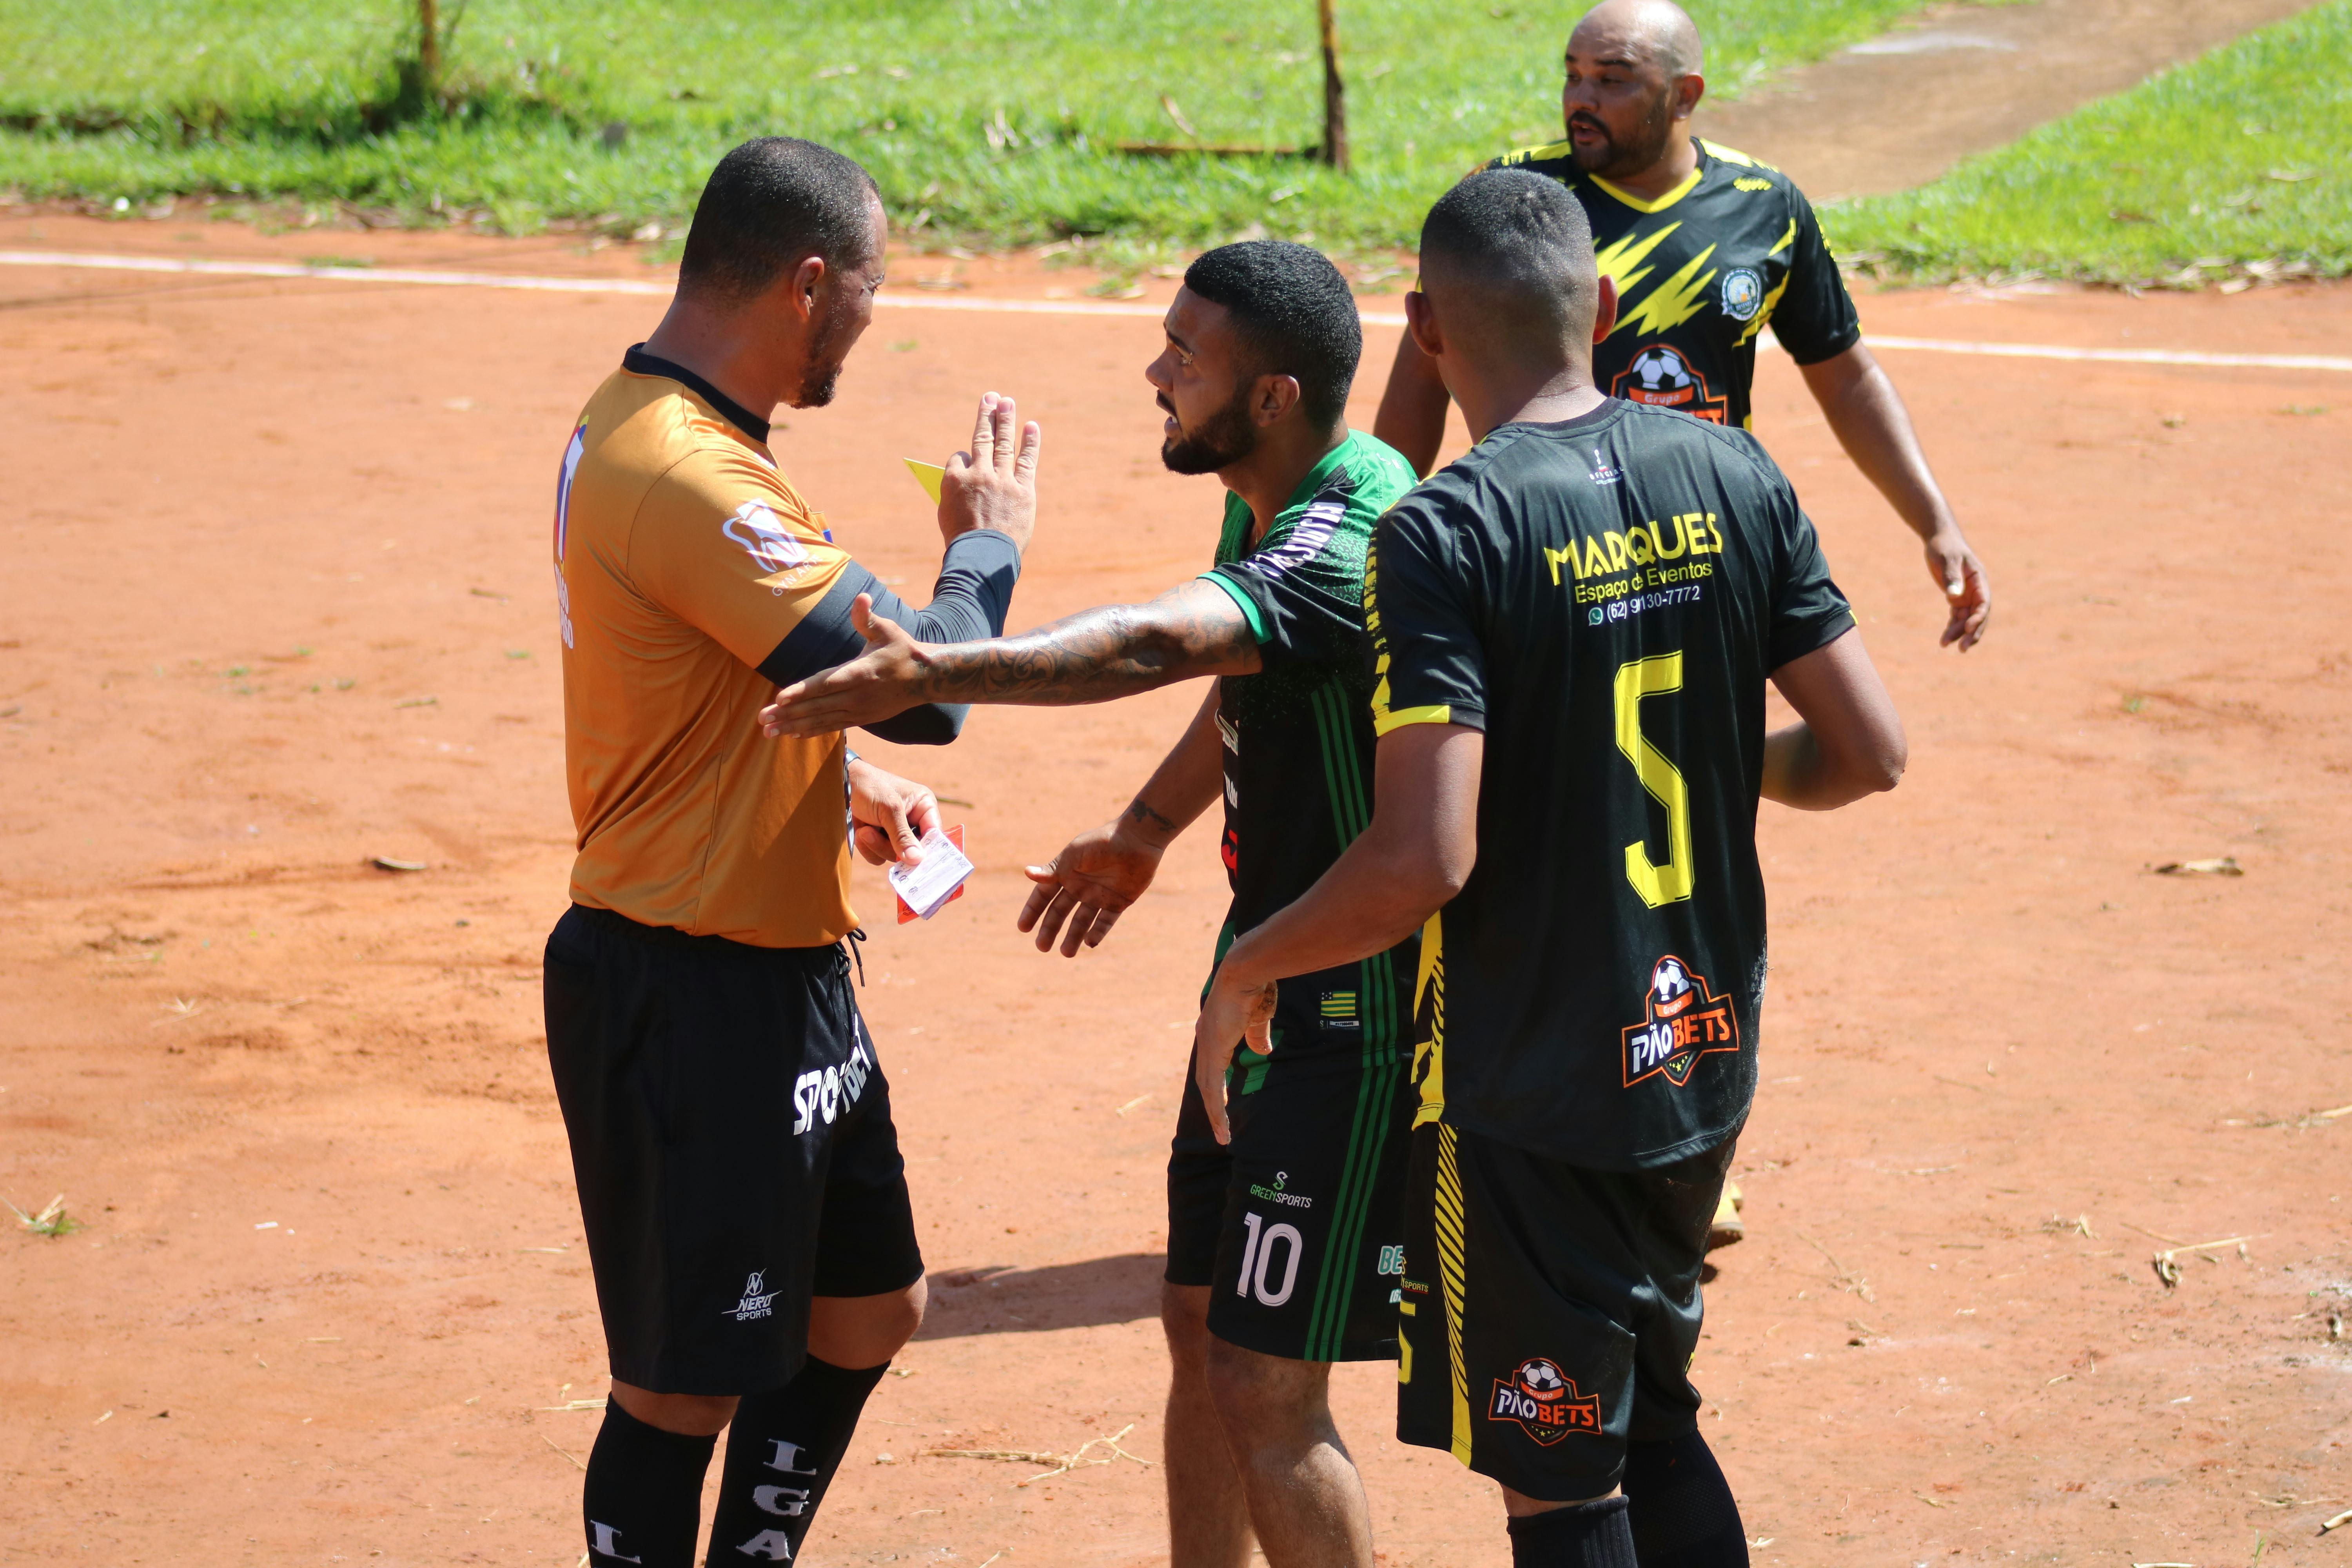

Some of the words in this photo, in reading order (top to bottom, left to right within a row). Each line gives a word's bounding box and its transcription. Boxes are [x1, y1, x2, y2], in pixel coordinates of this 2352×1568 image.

[1644, 393, 1681, 406] Grupo
[1544, 513, 1723, 586] MARQUES
[772, 573, 797, 596] GYN
[1574, 581, 1628, 603] Espaço
[1646, 561, 1712, 586] Eventos
[1607, 600, 1627, 623] (62)
[1614, 650, 1695, 909] 5
[1663, 1000, 1682, 1015] Grupo
[1250, 1184, 1312, 1208] GREENSPORTS
[1237, 1211, 1302, 1307] 10
[735, 1294, 774, 1312] NERO
[737, 1308, 772, 1321] SPORTS
[1528, 1389, 1553, 1400] Grupo
